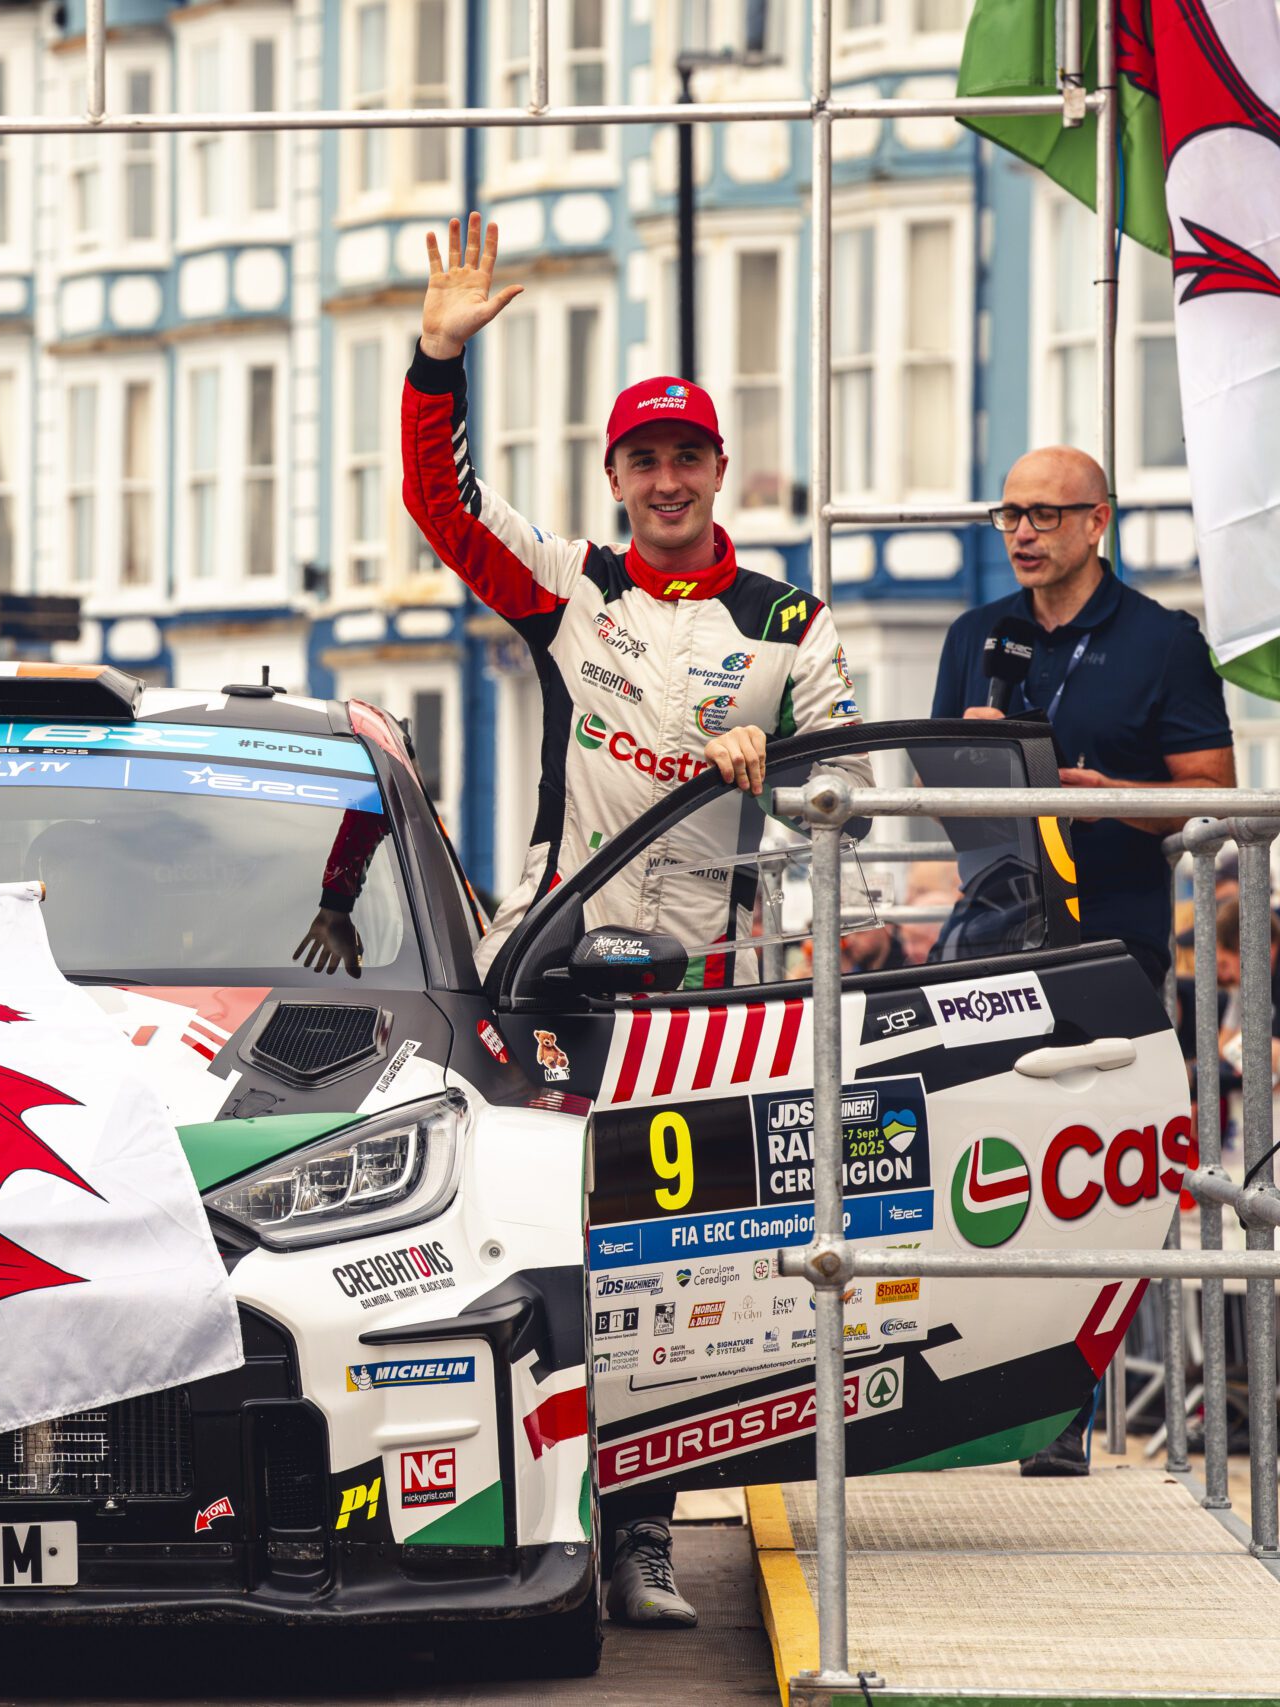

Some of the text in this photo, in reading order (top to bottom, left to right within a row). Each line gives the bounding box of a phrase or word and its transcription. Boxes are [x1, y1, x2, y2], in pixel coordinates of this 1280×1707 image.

[637, 396, 687, 409] Motorsport
[663, 580, 699, 597] P1
[780, 600, 807, 632] P1
[581, 660, 643, 702] CREIGHTONS
[688, 667, 744, 681] Motorsport
[704, 679, 741, 689] Ireland
[239, 738, 323, 757] #ForDai
[208, 775, 339, 800] ERC
[598, 937, 642, 948] Melvyn
[611, 946, 650, 955] Evans
[938, 987, 1042, 1023] PROBITE
[771, 1101, 814, 1128] JDS
[857, 1128, 879, 1140] Sept
[849, 1141, 885, 1157] 2025
[649, 1111, 694, 1210] 9
[770, 1156, 912, 1195] CERIGION
[671, 1211, 851, 1247] FIA ERC Championp
[332, 1241, 454, 1298] CREIGHTONS
[598, 1279, 623, 1296] JDS
[624, 1278, 660, 1291] MACHINERY
[694, 1272, 740, 1286] Ceredigion
[360, 1277, 456, 1310] BALMORAL FINAGHY BLACKS ROAD
[694, 1303, 724, 1315] MORGAN
[598, 1312, 635, 1330] ETT
[696, 1315, 720, 1326] DAVIES
[716, 1346, 746, 1355] SYSTEMS
[717, 1338, 754, 1348] SIGNATURE
[375, 1362, 469, 1381] MICHELIN
[700, 1357, 811, 1380] www.MelvynEvansMotorsport.com
[404, 1452, 454, 1489] NG
[335, 1476, 382, 1530] P1
[404, 1490, 454, 1504] nickygrist.com
[205, 1502, 227, 1520] TOW
